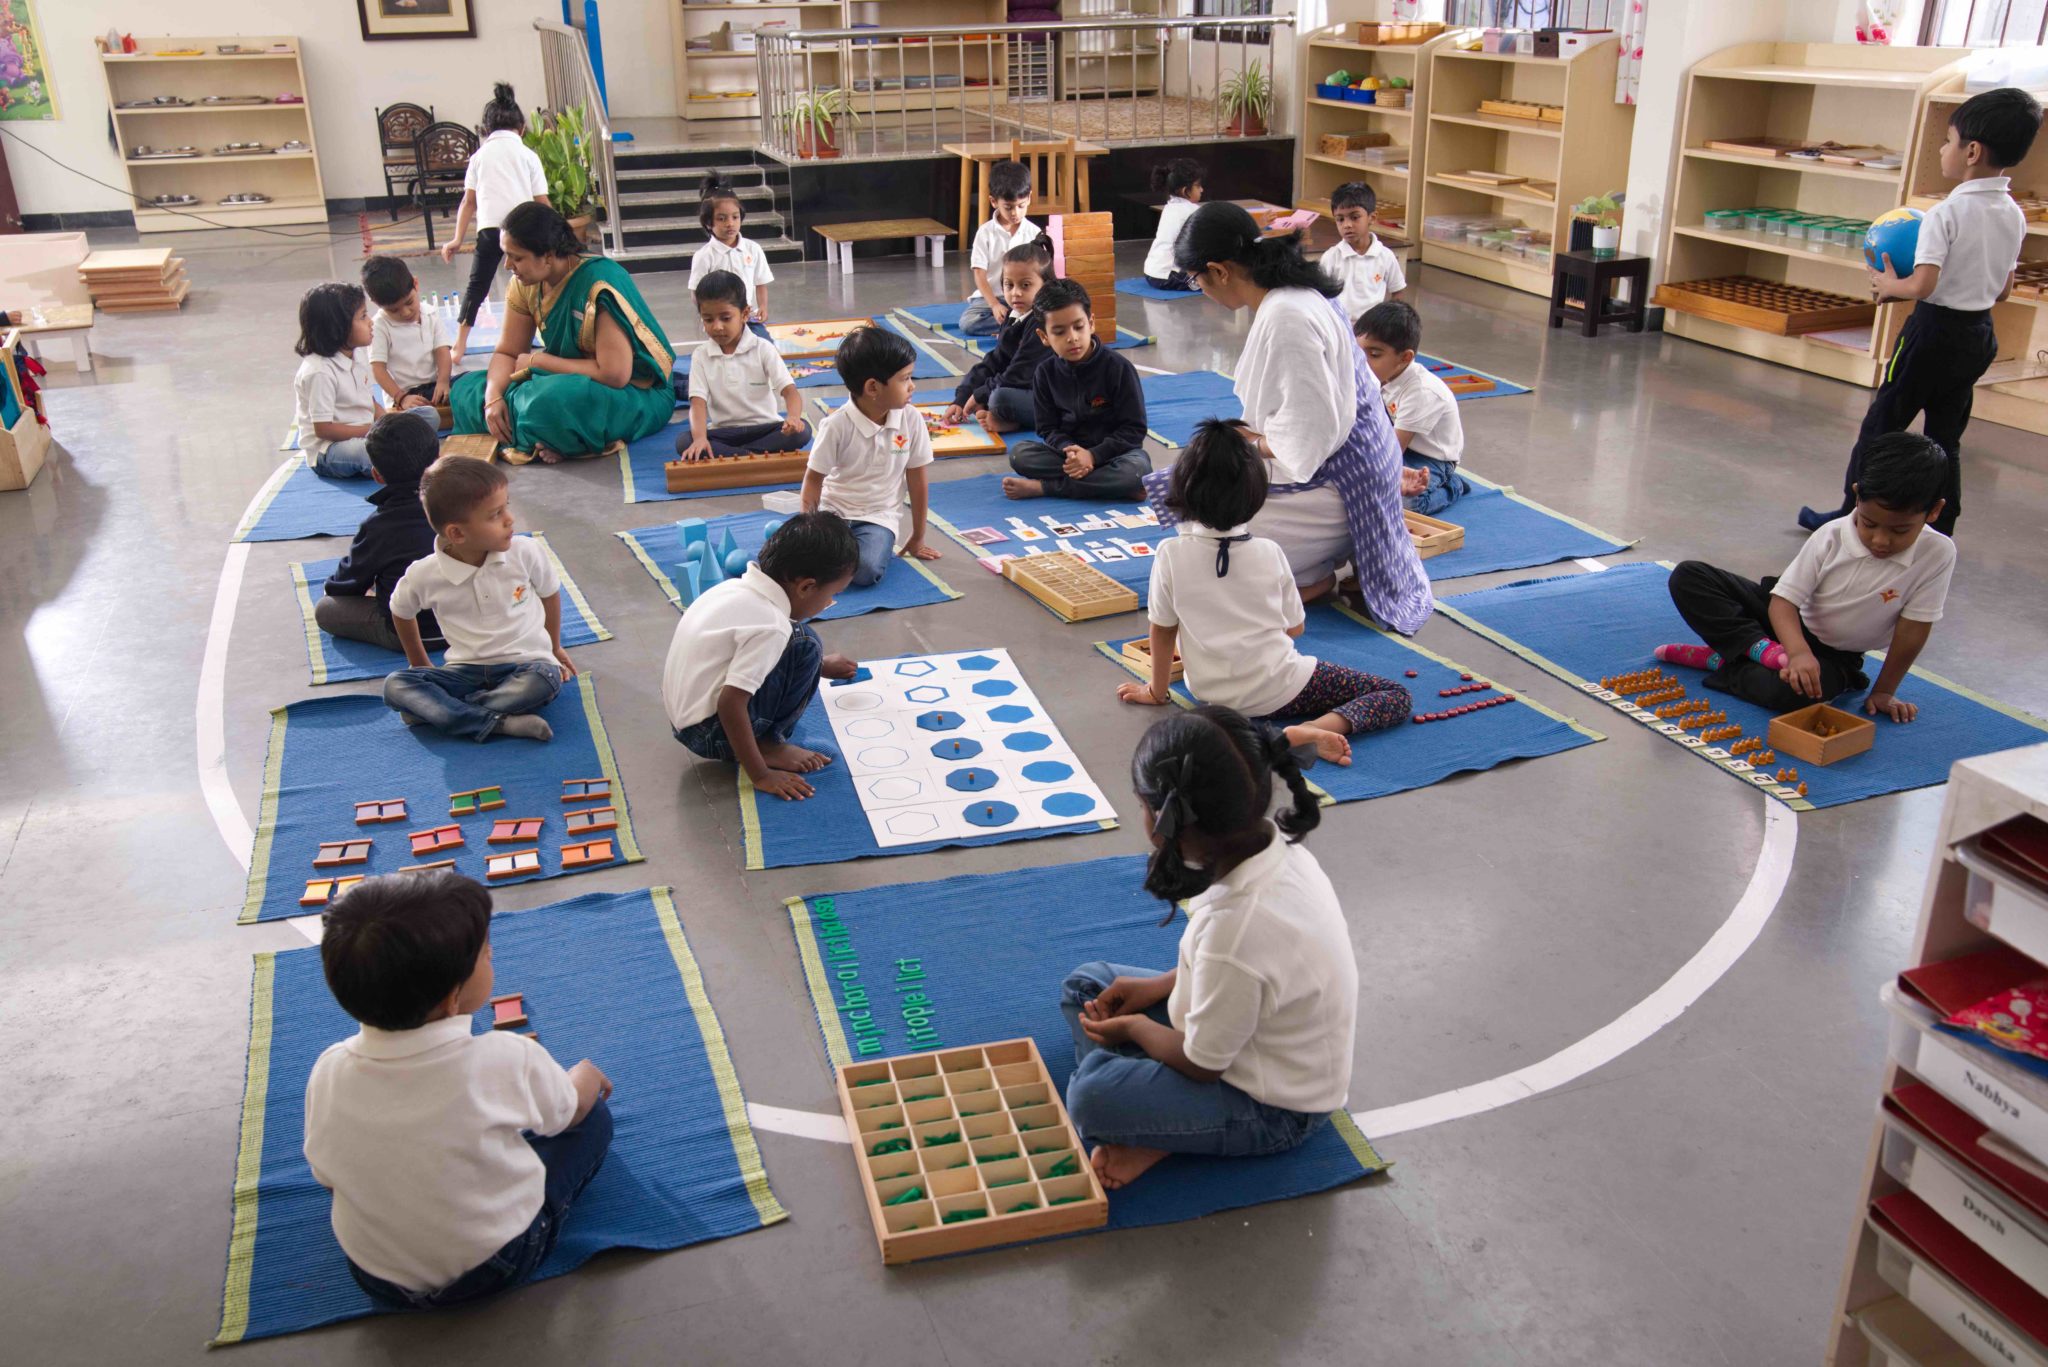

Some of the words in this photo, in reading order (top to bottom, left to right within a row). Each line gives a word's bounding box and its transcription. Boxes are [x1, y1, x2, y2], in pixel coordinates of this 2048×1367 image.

[1730, 761, 1748, 769] 3
[1964, 1070, 2020, 1119] Nabhya
[1962, 1196, 2006, 1236] Darsh
[1957, 1311, 2016, 1364] Anshika
